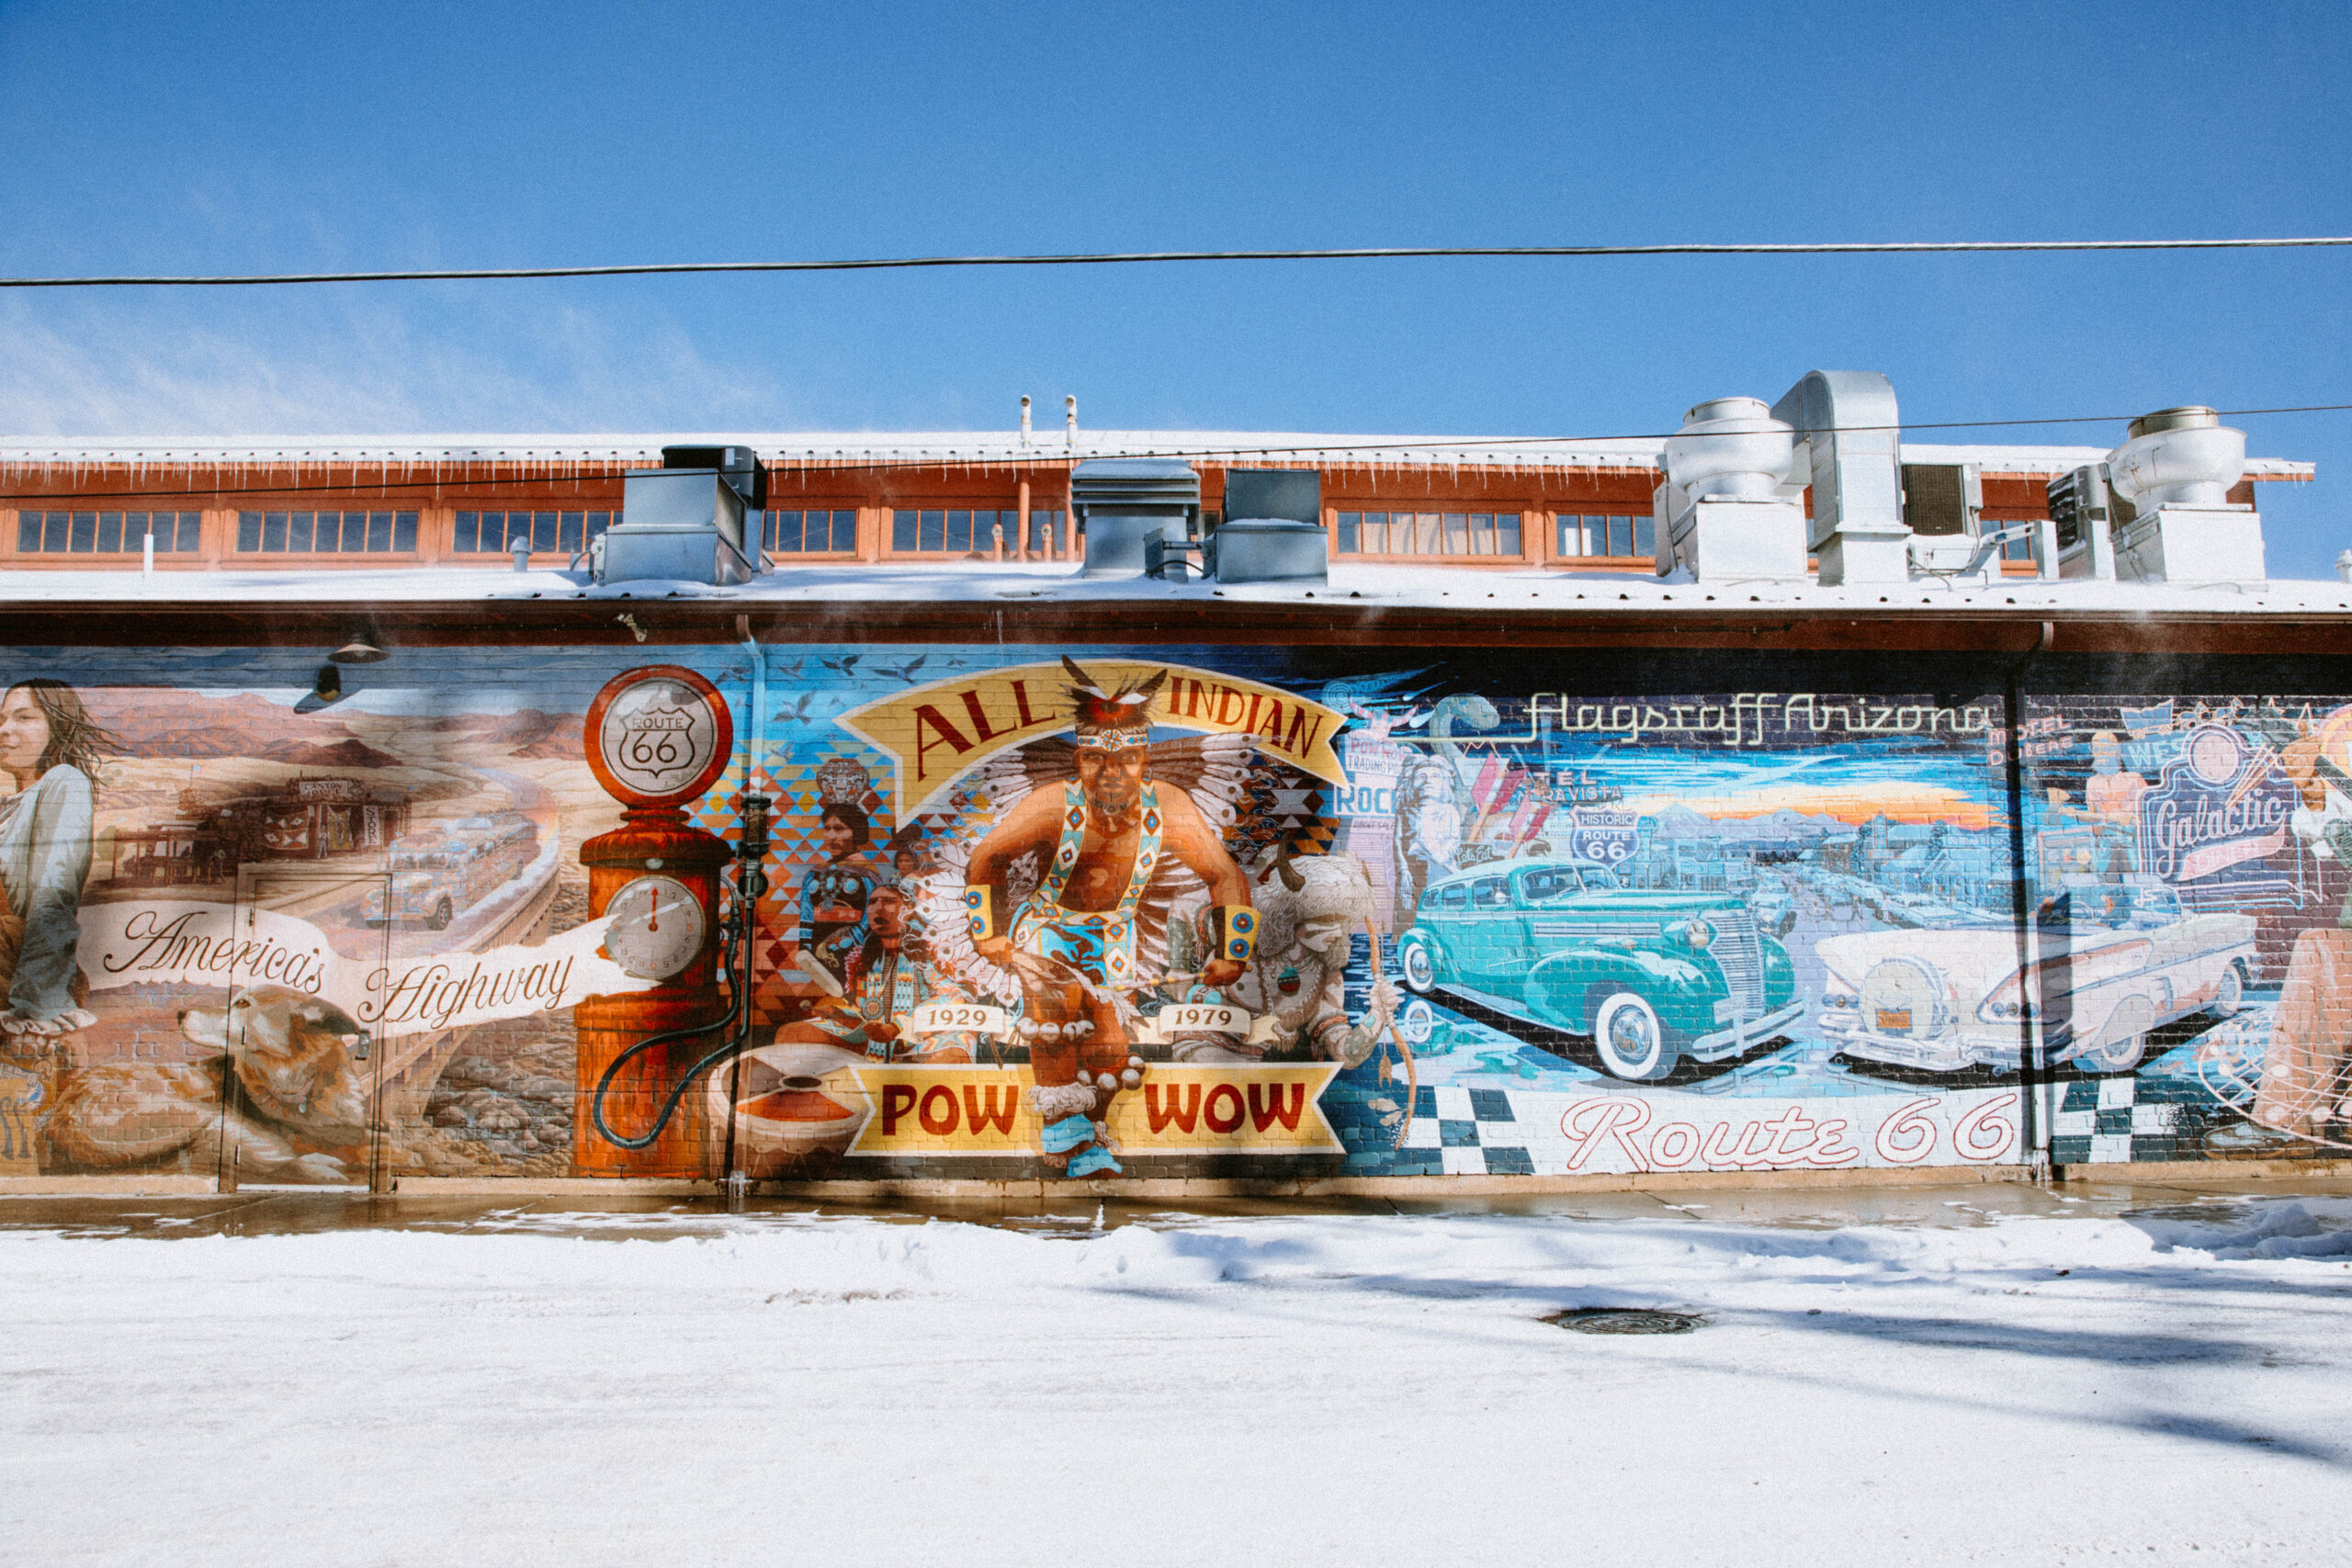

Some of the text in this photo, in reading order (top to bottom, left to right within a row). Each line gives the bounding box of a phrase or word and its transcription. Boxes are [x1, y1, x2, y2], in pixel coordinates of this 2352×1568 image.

[632, 717, 684, 728] ROUTE
[914, 676, 1323, 782] ALL INDIAN
[1781, 693, 1990, 734] Arizona
[1988, 715, 2073, 747] MOTEL
[633, 732, 677, 763] 66
[1348, 755, 1386, 774] TRADING
[1532, 770, 1597, 785] TEL
[366, 807, 378, 845] STORE
[1580, 814, 1633, 825] HISTORIC
[2156, 788, 2288, 879] Galactic
[1582, 831, 1632, 840] ROUTE
[1586, 841, 1627, 860] 66
[103, 910, 574, 1030] America's Highway
[928, 1009, 987, 1026] 1929
[1175, 1008, 1232, 1025] 1979
[882, 1083, 1306, 1136] POW WOW
[1561, 1093, 2018, 1172] Route 66
